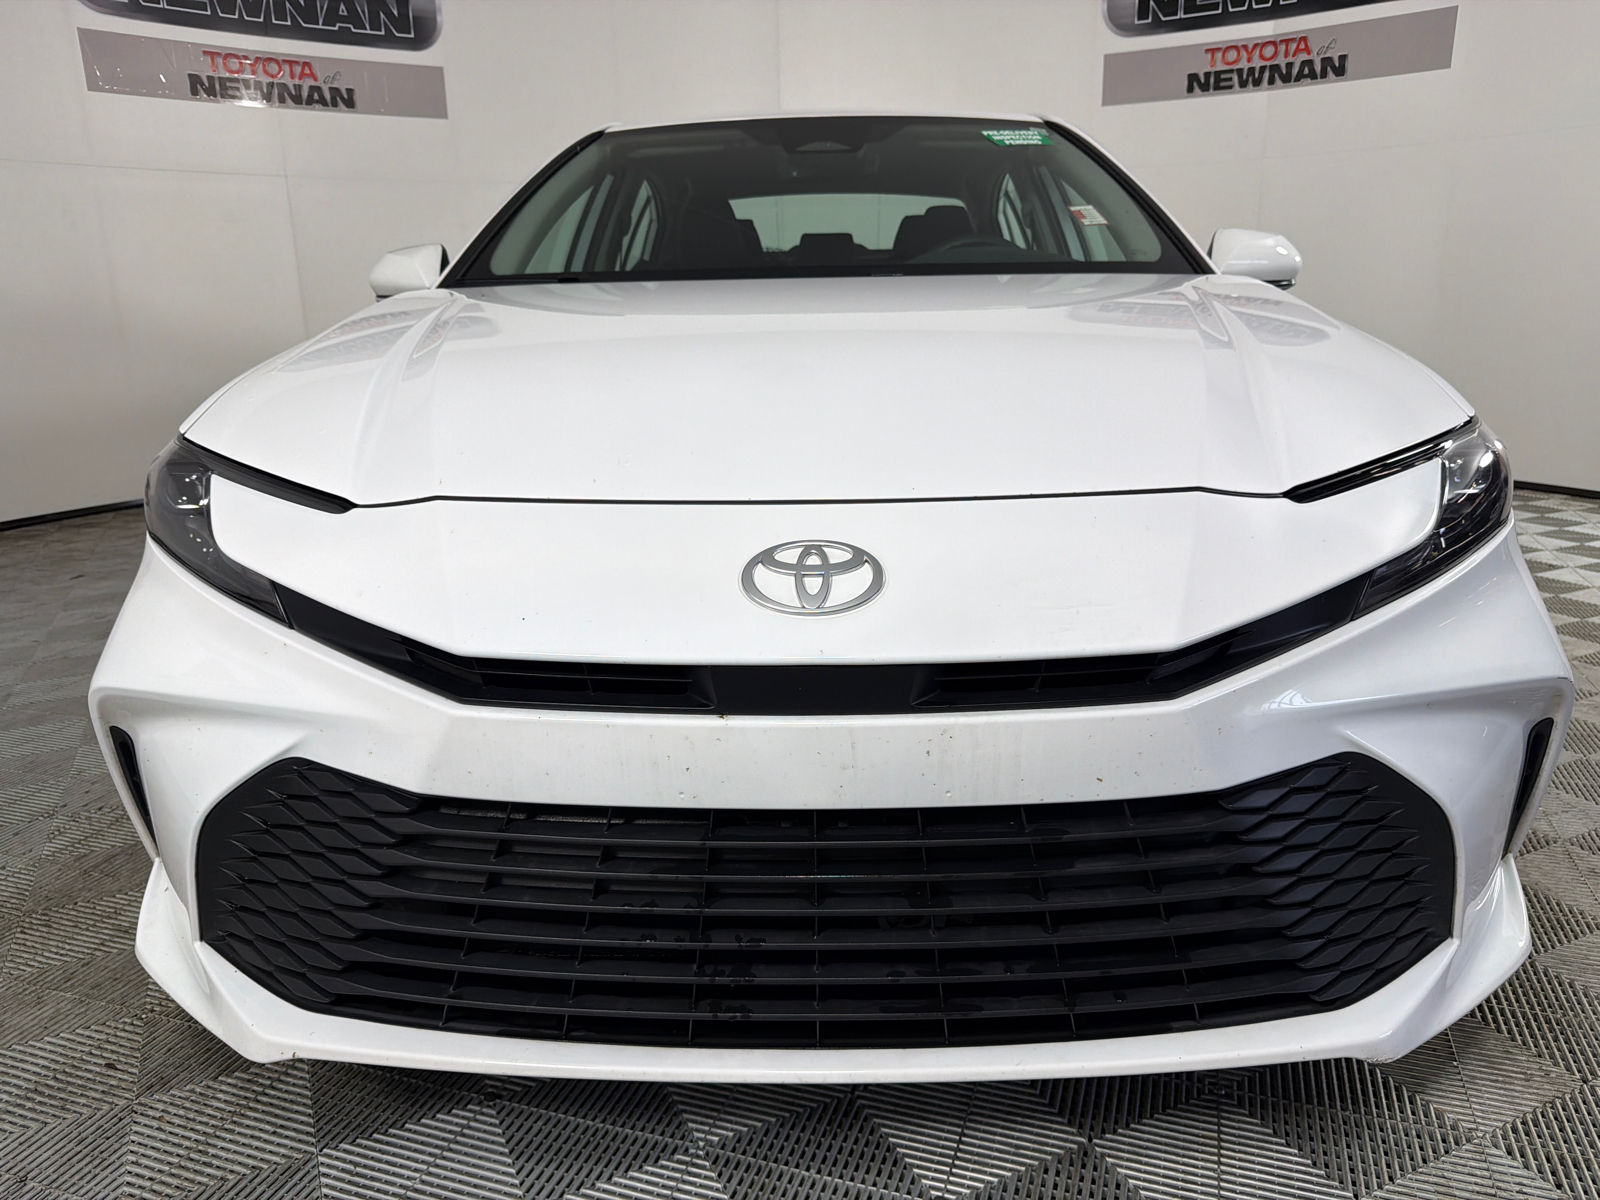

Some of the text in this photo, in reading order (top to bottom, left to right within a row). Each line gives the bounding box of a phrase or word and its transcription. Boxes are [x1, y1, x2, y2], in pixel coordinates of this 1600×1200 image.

[115, 0, 414, 38] NAN
[202, 50, 341, 85] TOYOTA of
[1205, 36, 1337, 68] TOYOTA of
[187, 73, 356, 109] NEWNAN
[1186, 54, 1348, 94] NEWNAN
